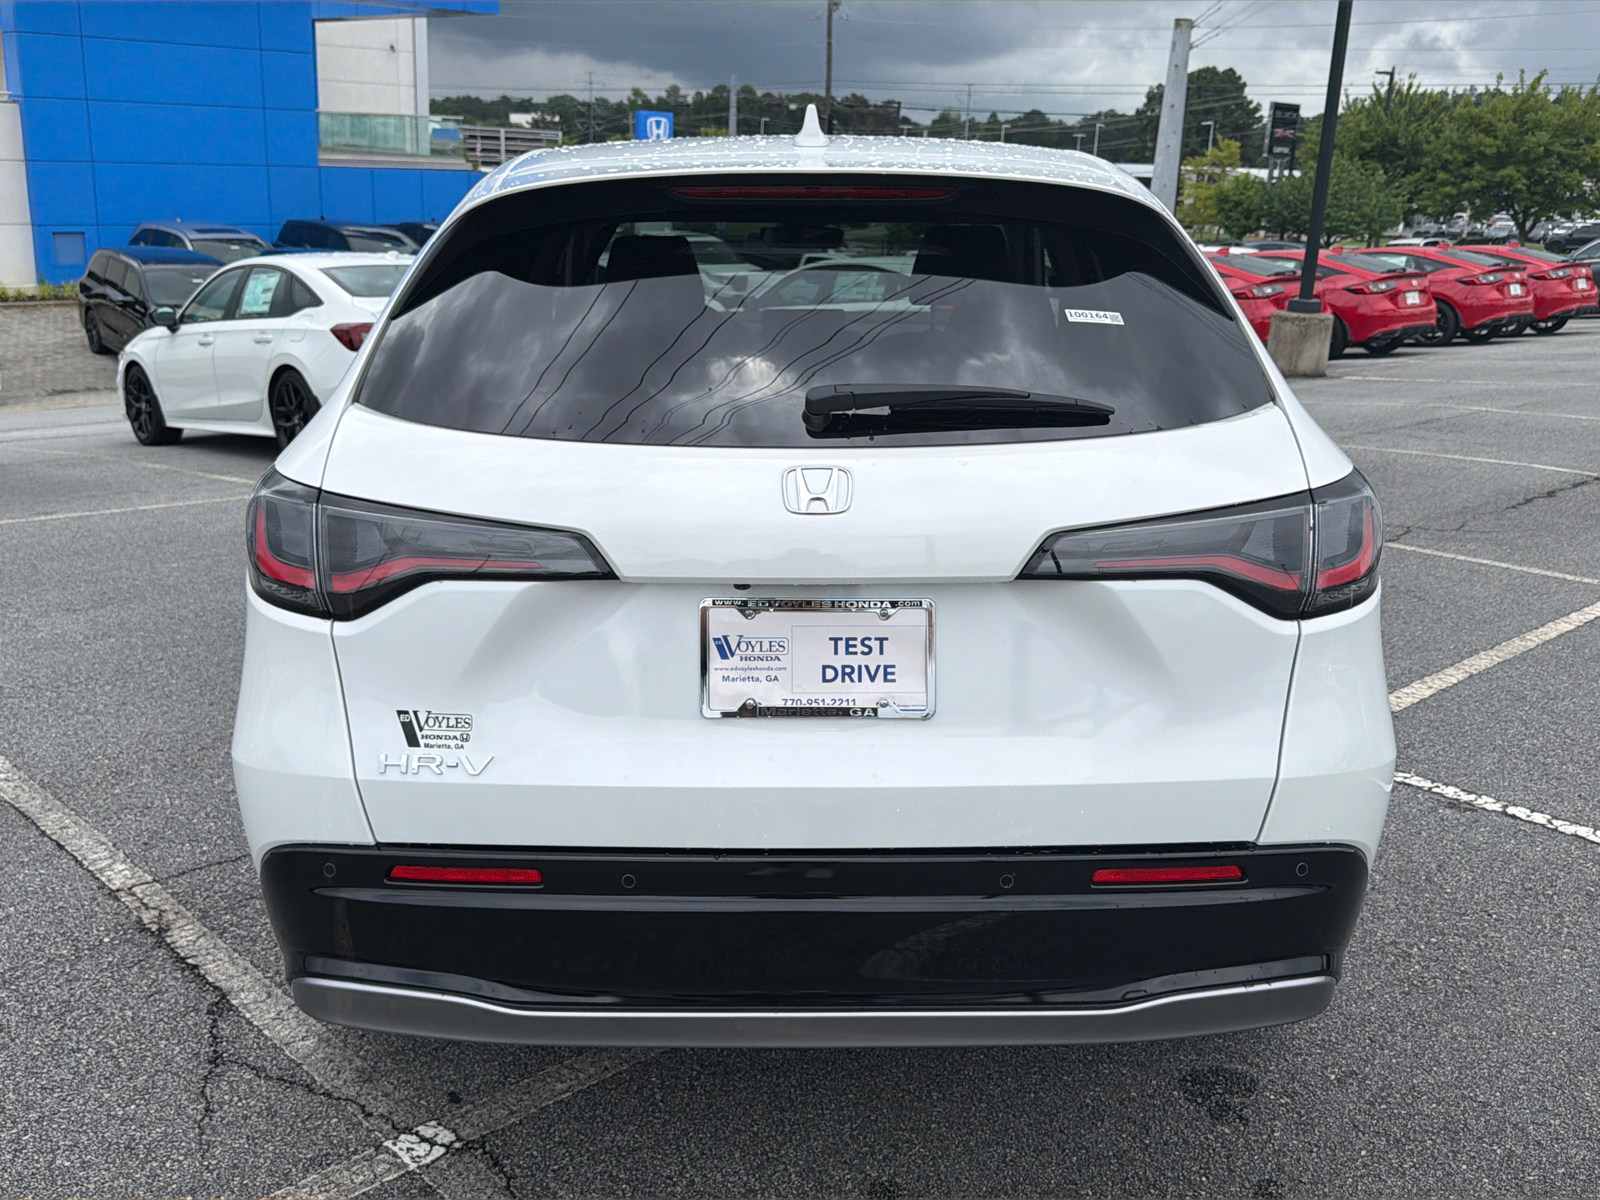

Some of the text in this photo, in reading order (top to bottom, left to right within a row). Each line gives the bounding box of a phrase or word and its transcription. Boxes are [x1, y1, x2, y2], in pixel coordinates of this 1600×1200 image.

[1067, 310, 1109, 319] 100164
[721, 634, 787, 658] VOYLES
[828, 636, 889, 656] TEST
[821, 664, 897, 683] DRIVE
[721, 675, 780, 683] Marietta, GA
[781, 698, 857, 706] 770-951-2211
[760, 707, 876, 717] Marietta, GA
[412, 710, 472, 733] VOYLES
[420, 733, 460, 741] HONDA
[423, 742, 453, 750] Marietta,
[378, 753, 495, 776] HR-V
